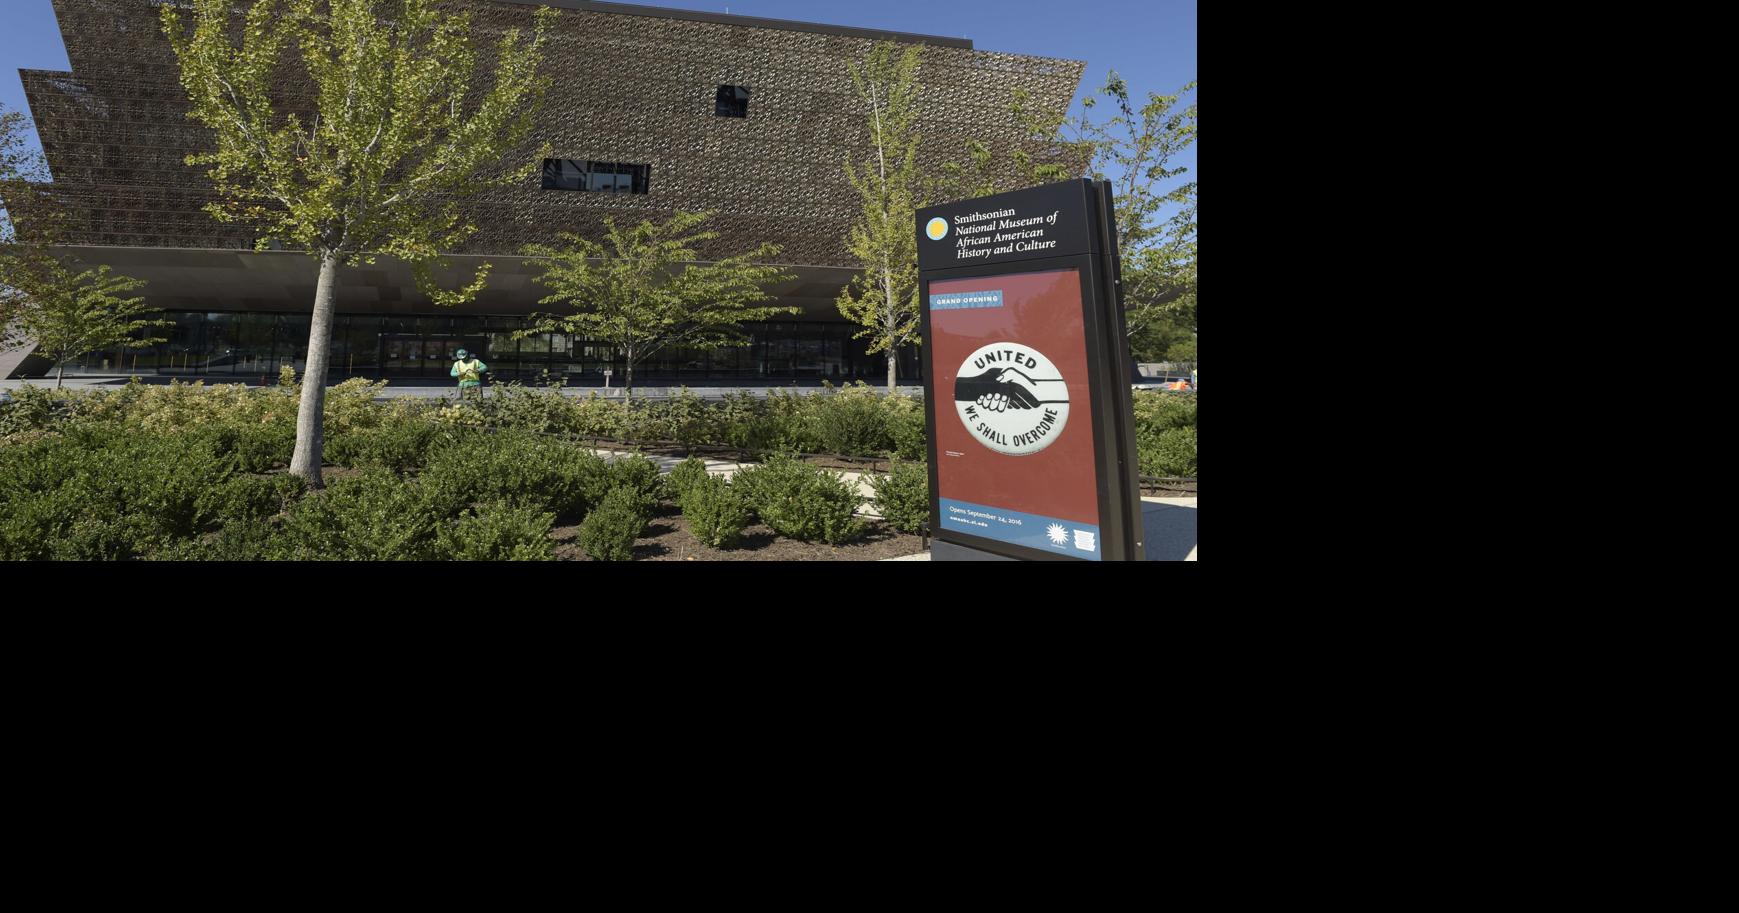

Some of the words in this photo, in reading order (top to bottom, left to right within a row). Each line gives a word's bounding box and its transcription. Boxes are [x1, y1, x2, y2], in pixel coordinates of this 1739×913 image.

[954, 208, 1015, 224] Smithsonian
[955, 220, 996, 236] National
[998, 216, 1043, 229] Museum
[1046, 210, 1059, 225] of
[956, 236, 991, 249] African
[993, 228, 1043, 242] American
[957, 248, 992, 259] History
[993, 242, 1013, 255] and
[1016, 239, 1056, 252] Culture
[963, 295, 998, 303] OPENING
[974, 350, 1037, 370] UNITED
[964, 405, 980, 422] WE
[976, 422, 1008, 446] SHALL
[1012, 407, 1058, 447] OVERCOME
[949, 505, 967, 514] Opens
[967, 509, 996, 521] September
[1008, 518, 1022, 526] 2016
